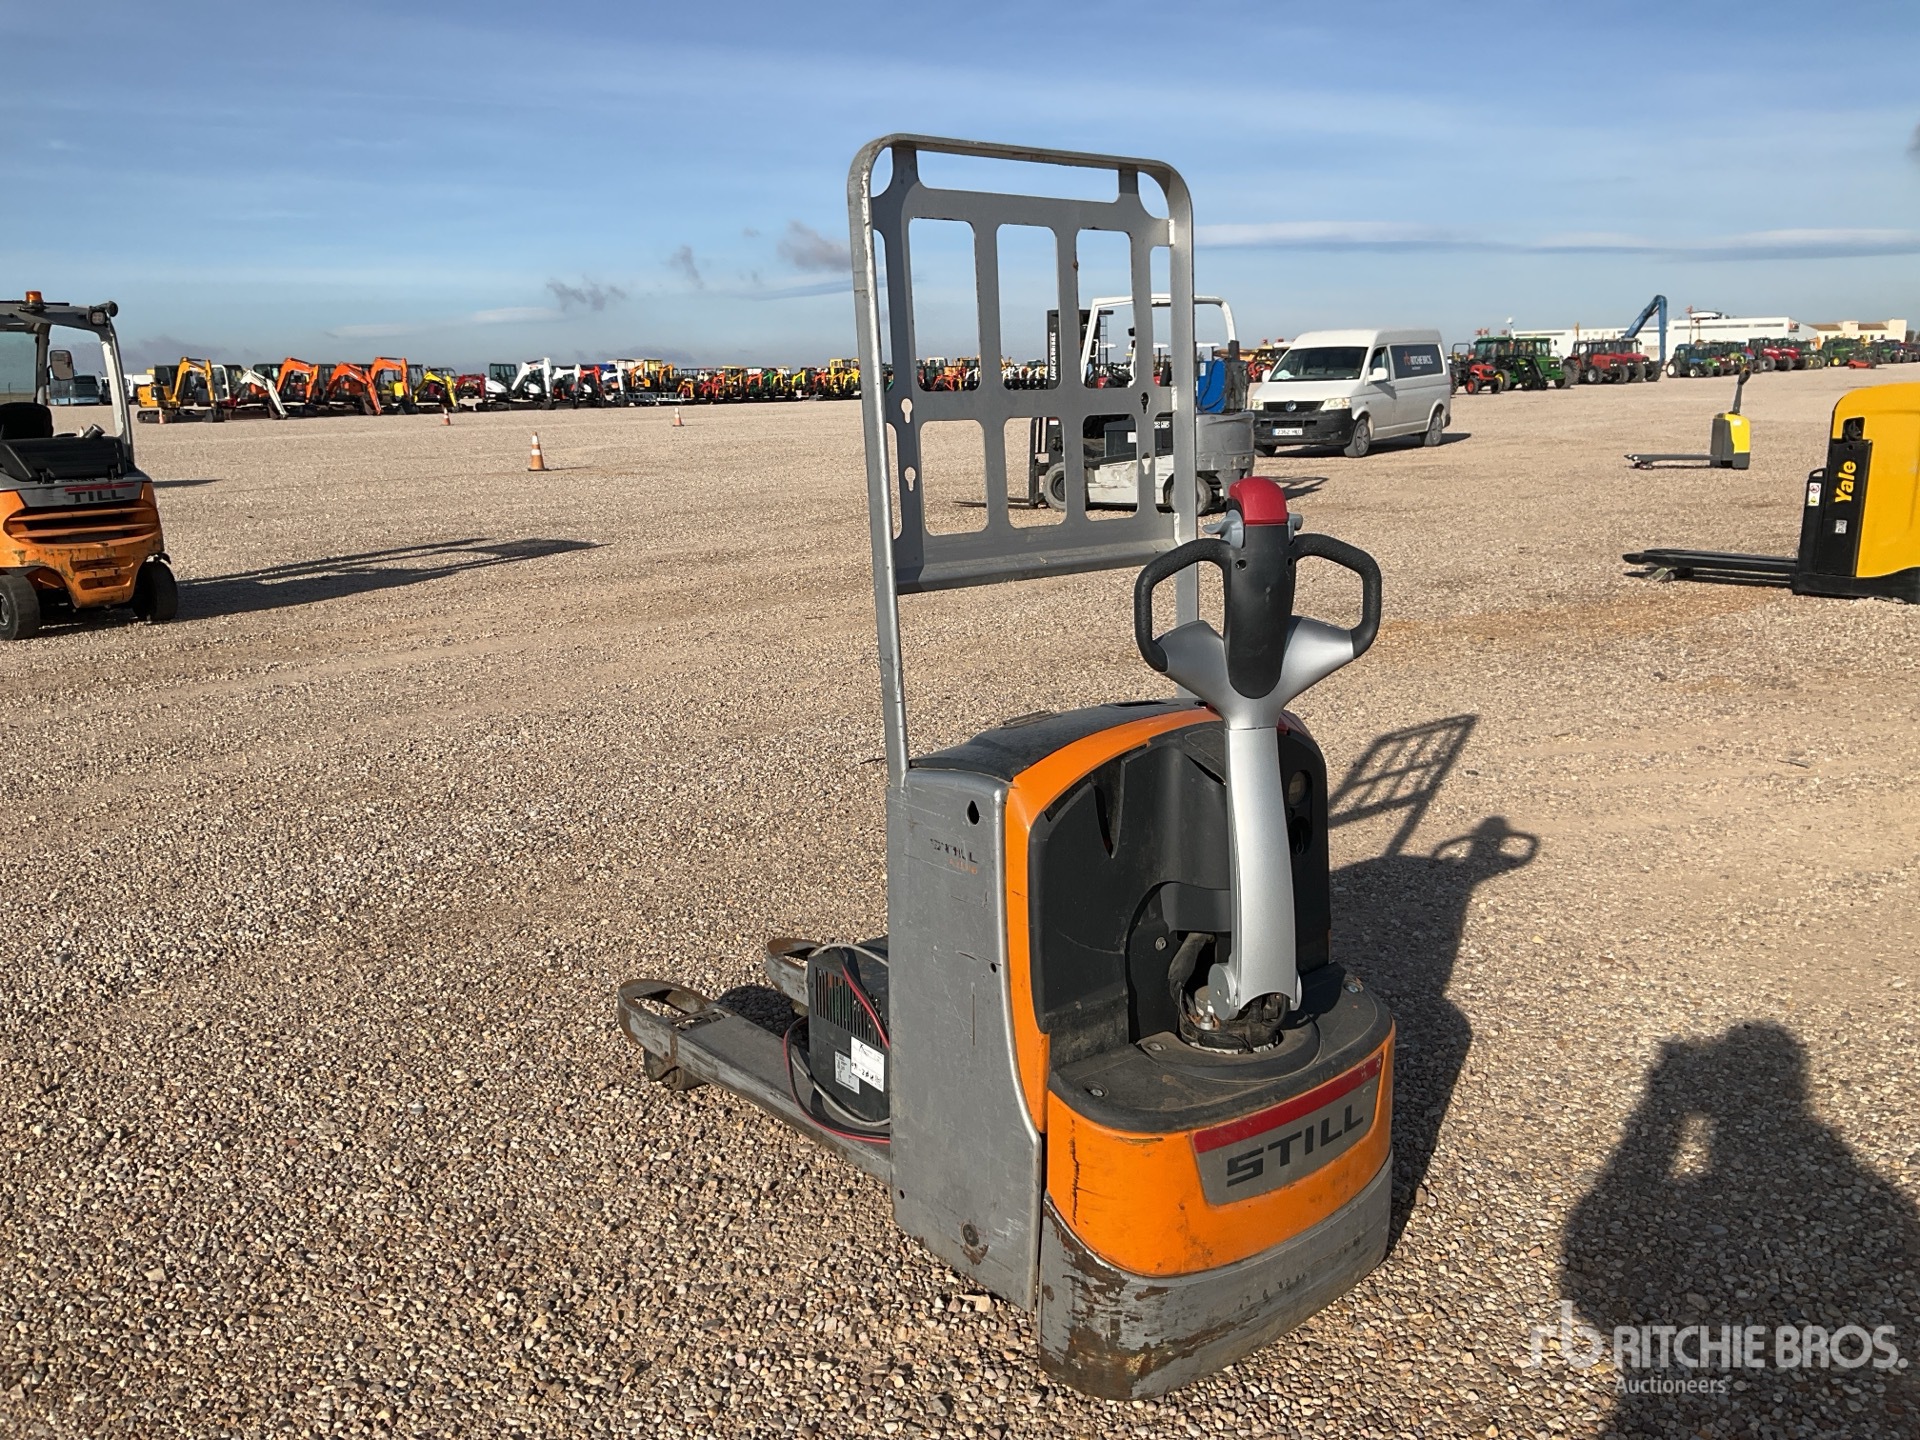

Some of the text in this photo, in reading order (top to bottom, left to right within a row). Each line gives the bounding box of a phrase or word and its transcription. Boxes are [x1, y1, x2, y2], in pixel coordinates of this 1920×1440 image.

[1049, 331, 1057, 381] UNICARRIERS
[1834, 460, 1857, 503] Yale
[929, 838, 979, 864] STILL
[1226, 1104, 1364, 1187] STILL
